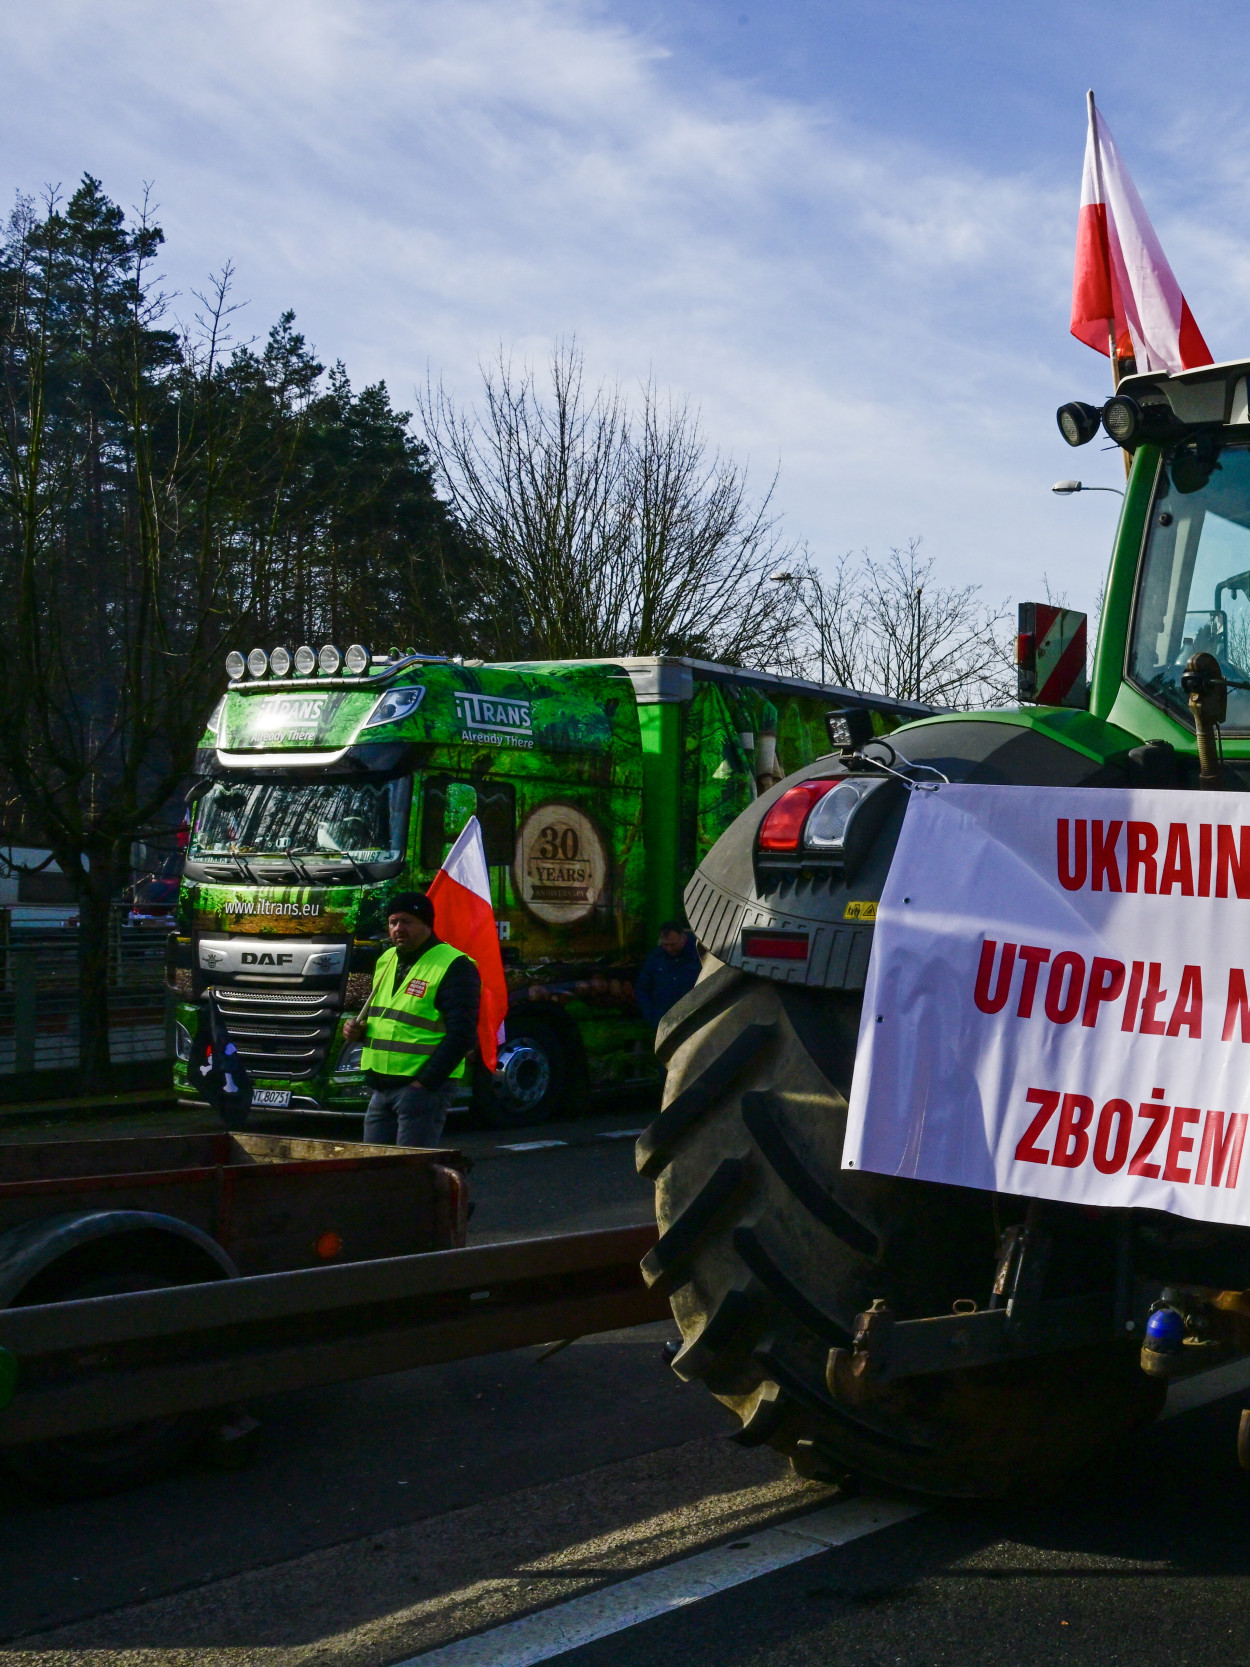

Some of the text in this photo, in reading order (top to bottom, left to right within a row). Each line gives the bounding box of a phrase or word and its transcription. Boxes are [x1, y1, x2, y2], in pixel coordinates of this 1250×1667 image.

[251, 730, 315, 743] Already There
[461, 730, 534, 749] Already There
[540, 826, 579, 860] 30
[536, 867, 586, 882] YEARS
[225, 898, 320, 917] www.iltrans.eu
[241, 953, 293, 966] DAF
[974, 939, 1203, 1039] UTOPIŁA
[1014, 1087, 1249, 1189] ZBOŻEM
